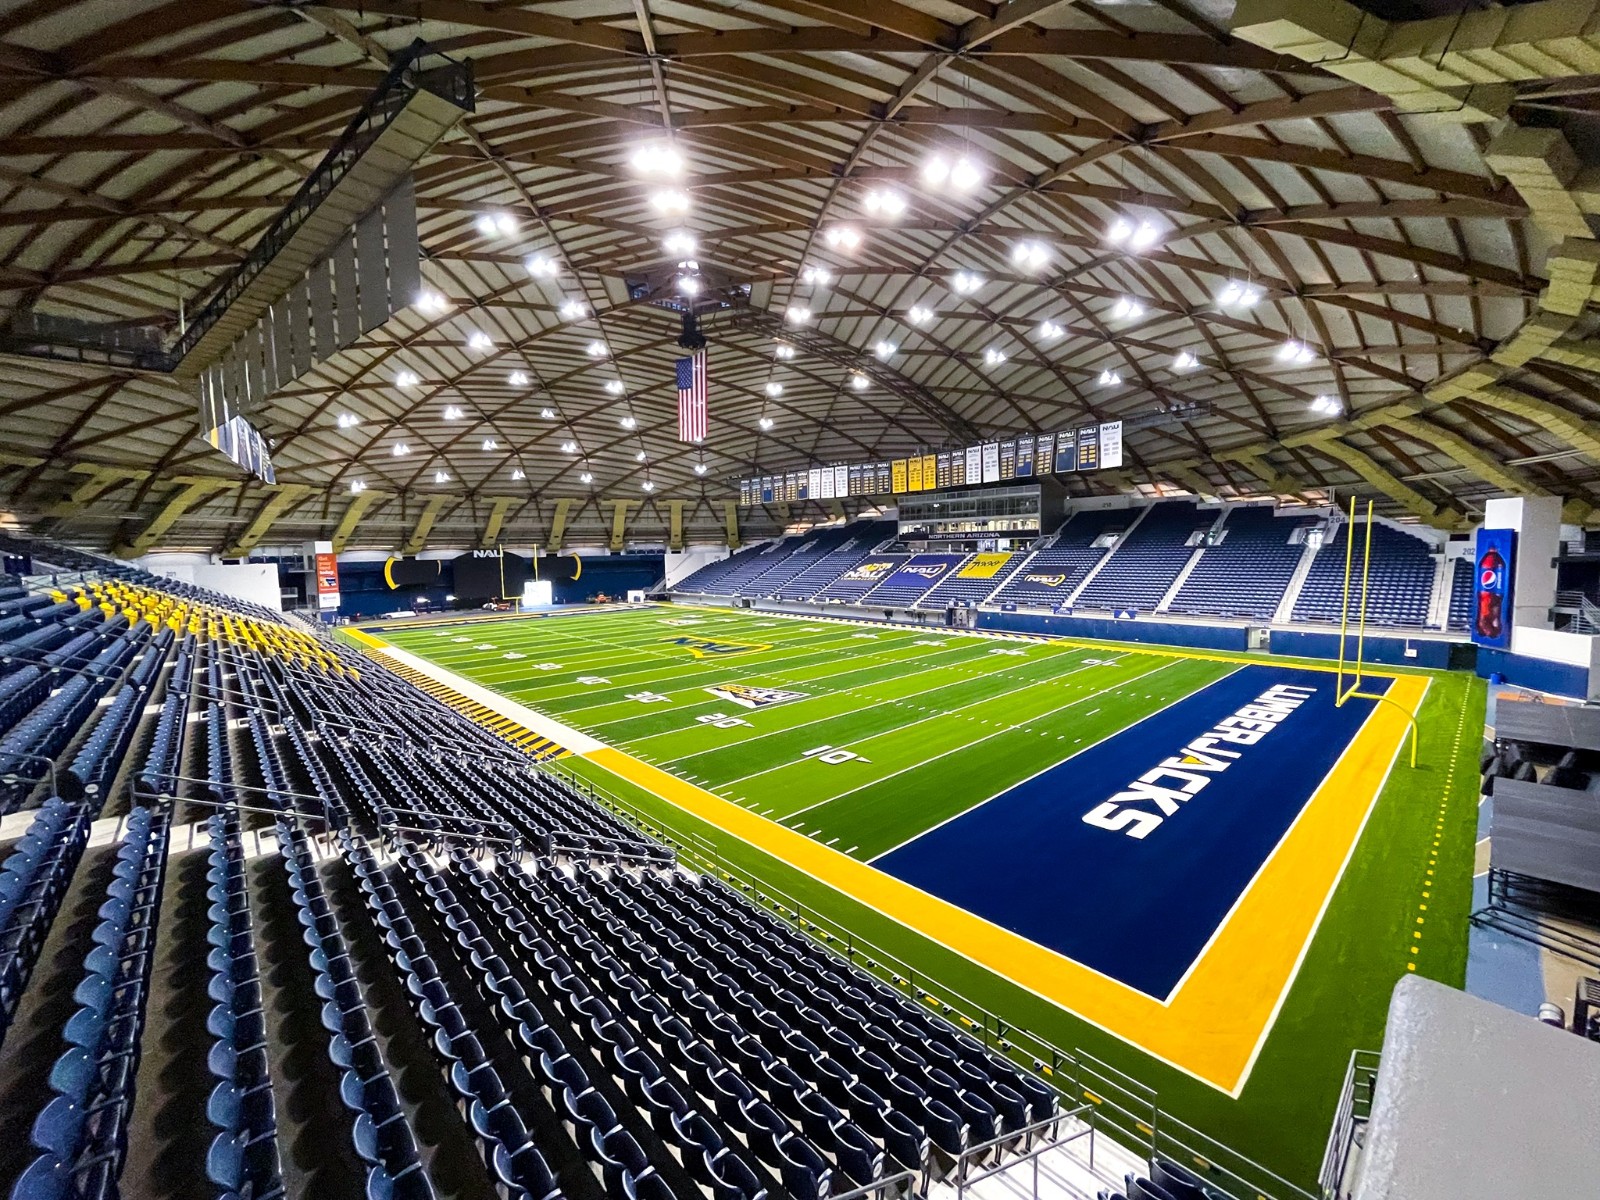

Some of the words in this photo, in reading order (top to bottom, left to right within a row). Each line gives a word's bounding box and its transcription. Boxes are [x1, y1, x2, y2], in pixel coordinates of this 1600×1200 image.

[695, 713, 747, 728] 20
[801, 745, 858, 764] 10
[1082, 684, 1318, 840] LUMBERJACKS
